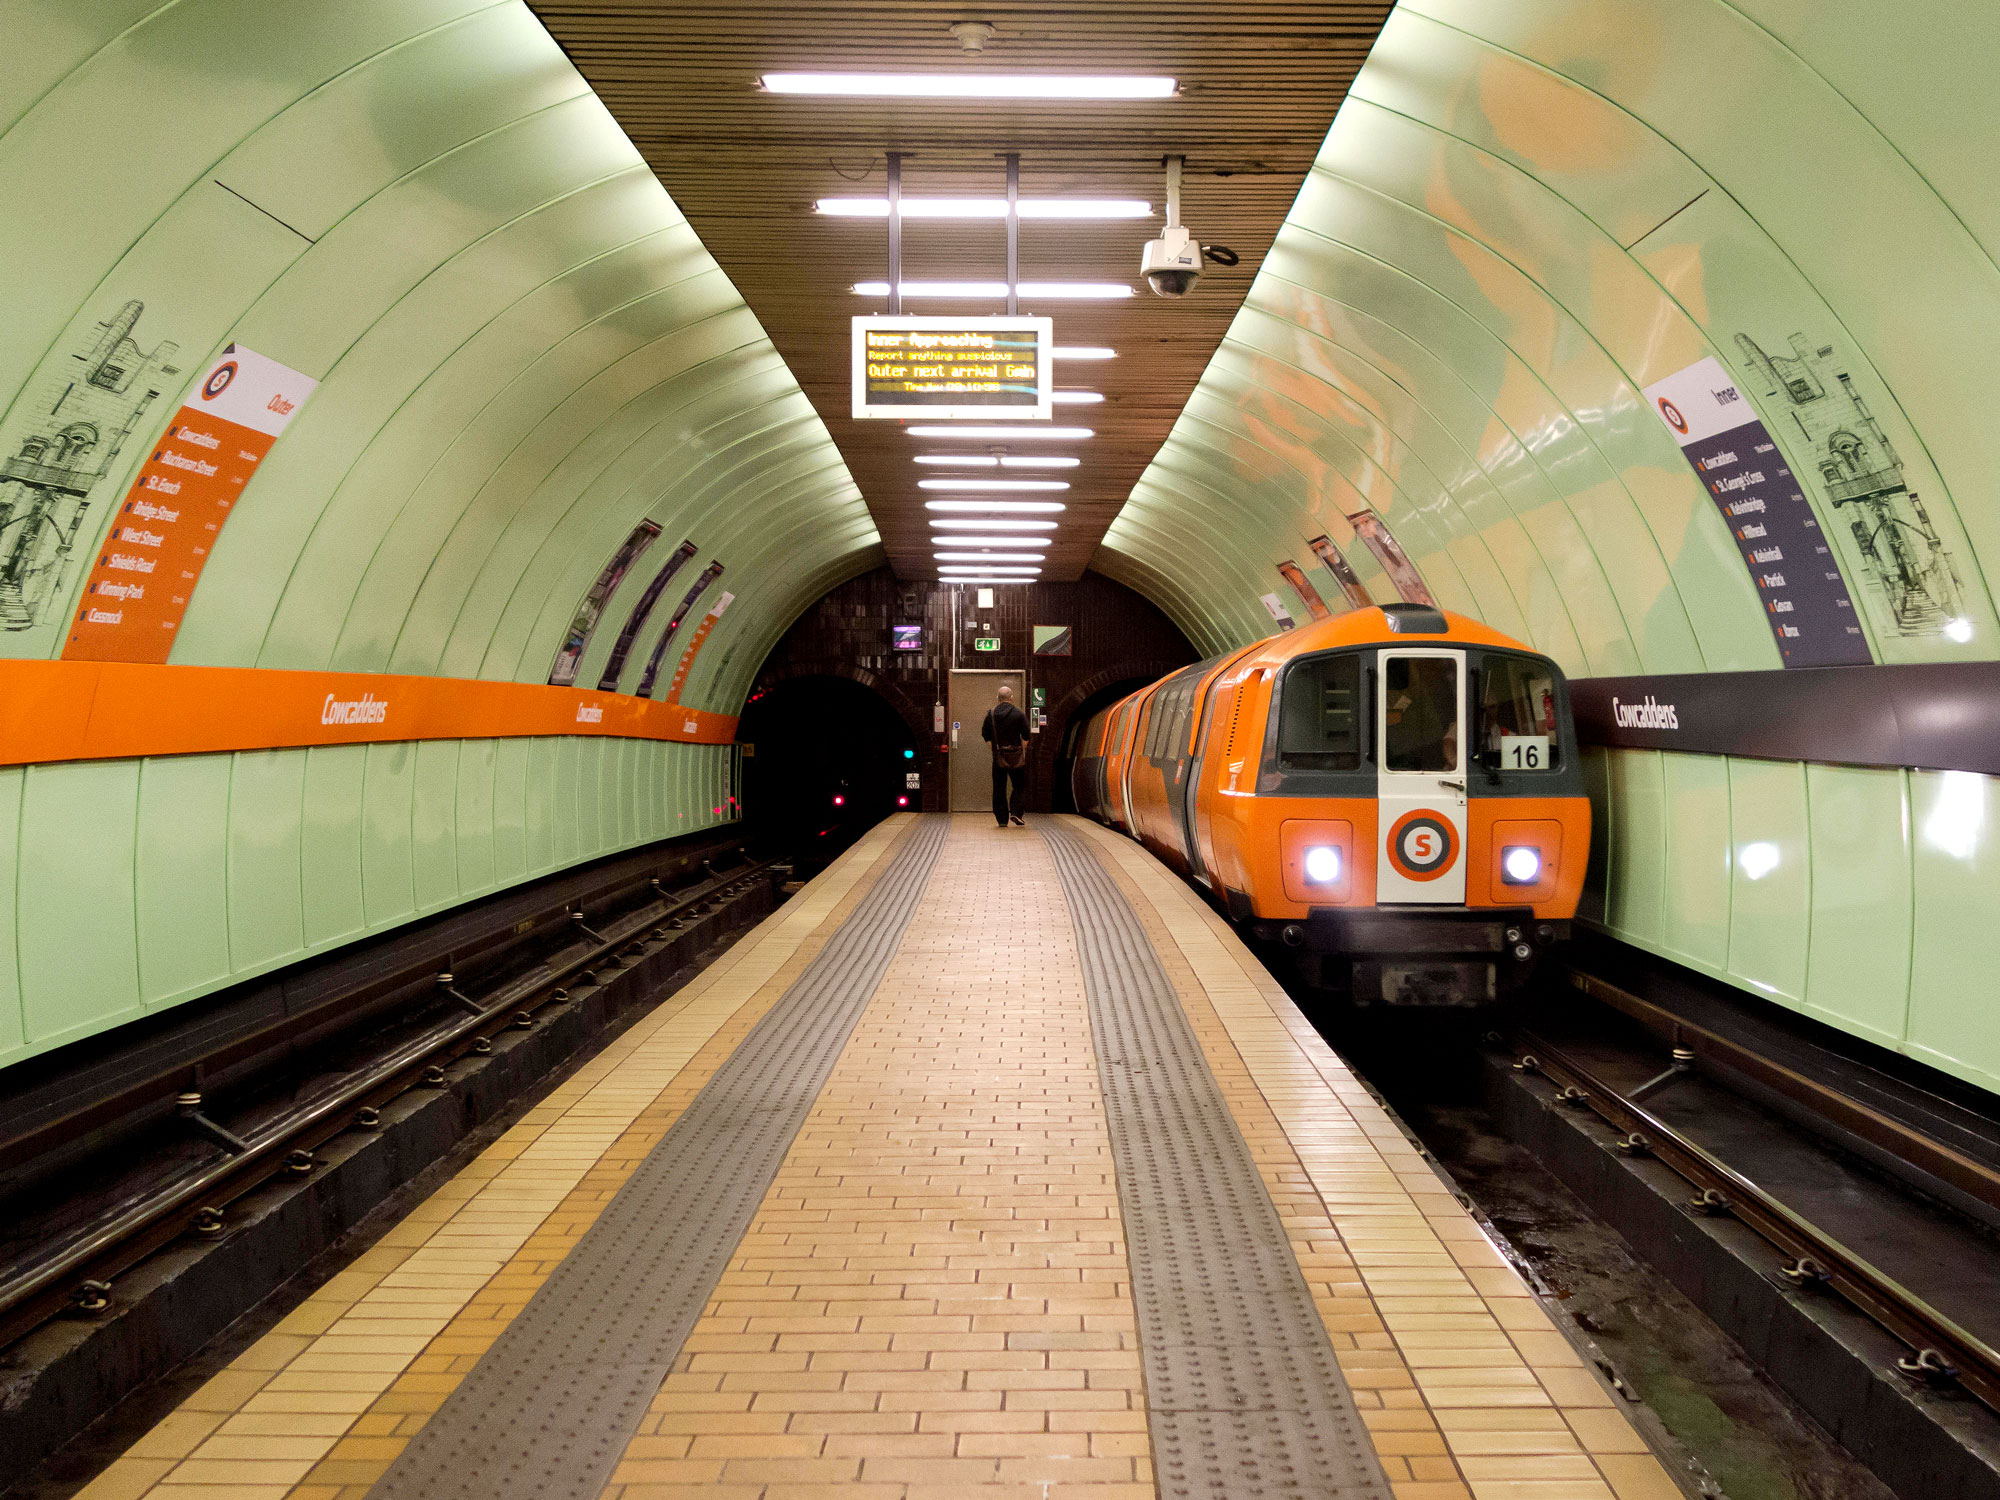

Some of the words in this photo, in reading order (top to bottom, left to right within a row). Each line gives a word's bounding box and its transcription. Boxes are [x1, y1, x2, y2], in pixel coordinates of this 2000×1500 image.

[868, 333, 905, 347] Inner
[909, 332, 994, 348] Approaching
[868, 351, 903, 361] Report
[908, 352, 953, 362] anything
[868, 364, 908, 378] Outer
[913, 365, 945, 378] next
[951, 365, 998, 378] arrival
[266, 393, 296, 416] Outer
[1710, 387, 1740, 407] Inner
[177, 426, 221, 450] Cowcaddens
[160, 450, 198, 471] Buchanan
[194, 459, 219, 477] Street
[1701, 450, 1739, 470] Cowcaddens
[158, 478, 182, 495] Enoch
[1745, 471, 1766, 485] Cross
[133, 500, 159, 521] Bridge
[155, 505, 180, 523] Street
[121, 527, 143, 544] West
[140, 530, 164, 548] Street
[109, 553, 138, 571] Shields
[135, 557, 157, 573] Road
[98, 580, 129, 601] Kinning
[126, 584, 145, 600] Park
[88, 608, 123, 625] Cessnock
[321, 692, 388, 725] Cowcaddens
[1612, 695, 1679, 730] Cowcaddens
[1512, 745, 1539, 768] 16
[1415, 834, 1431, 857] S
